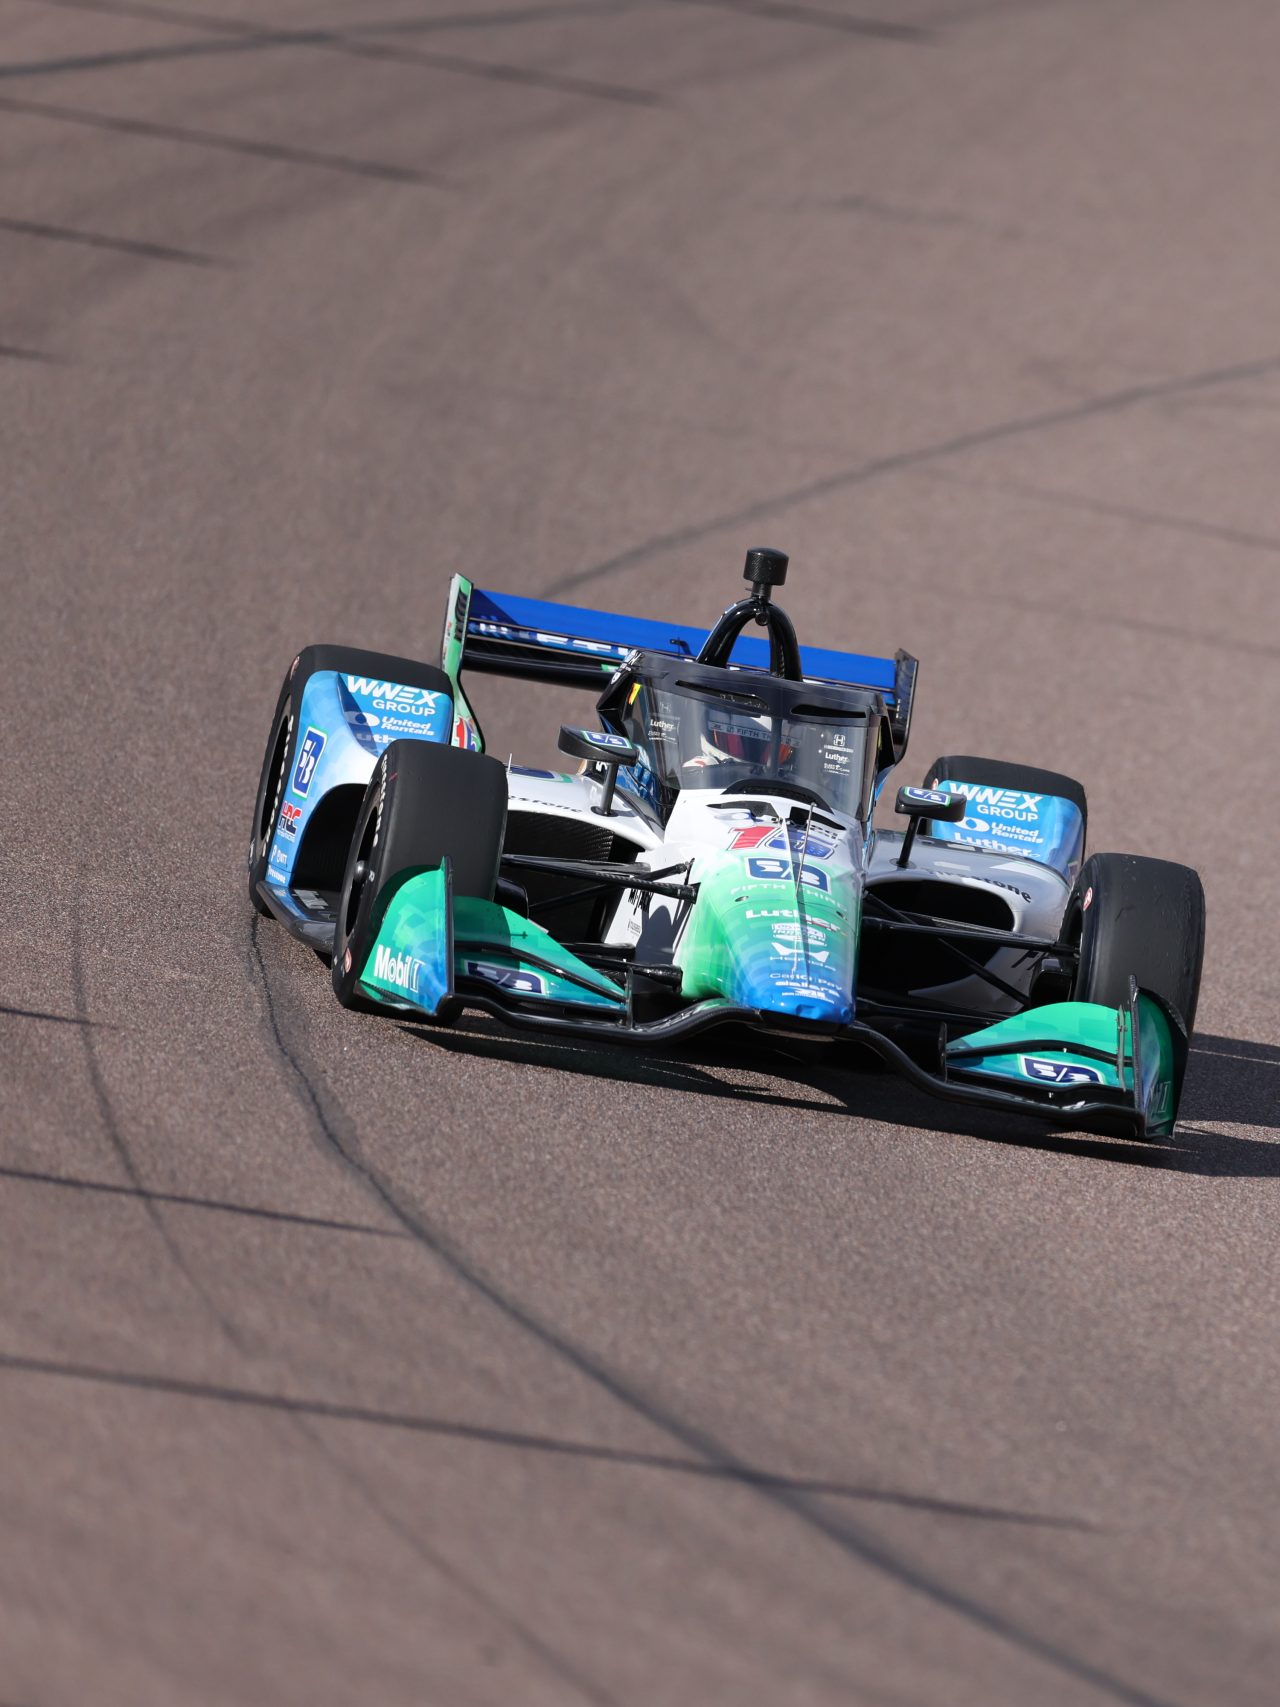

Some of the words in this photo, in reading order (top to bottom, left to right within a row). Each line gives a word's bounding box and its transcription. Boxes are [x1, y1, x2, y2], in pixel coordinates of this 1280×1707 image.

[372, 699, 436, 717] GROUP
[381, 716, 432, 730] United
[381, 723, 435, 737] Rentals
[977, 804, 1039, 822] GROUP
[991, 822, 1039, 836] United
[991, 829, 1044, 845] Rentals
[954, 832, 1032, 857] Luther
[730, 883, 786, 895] FIFTH
[373, 944, 411, 989] Mobil
